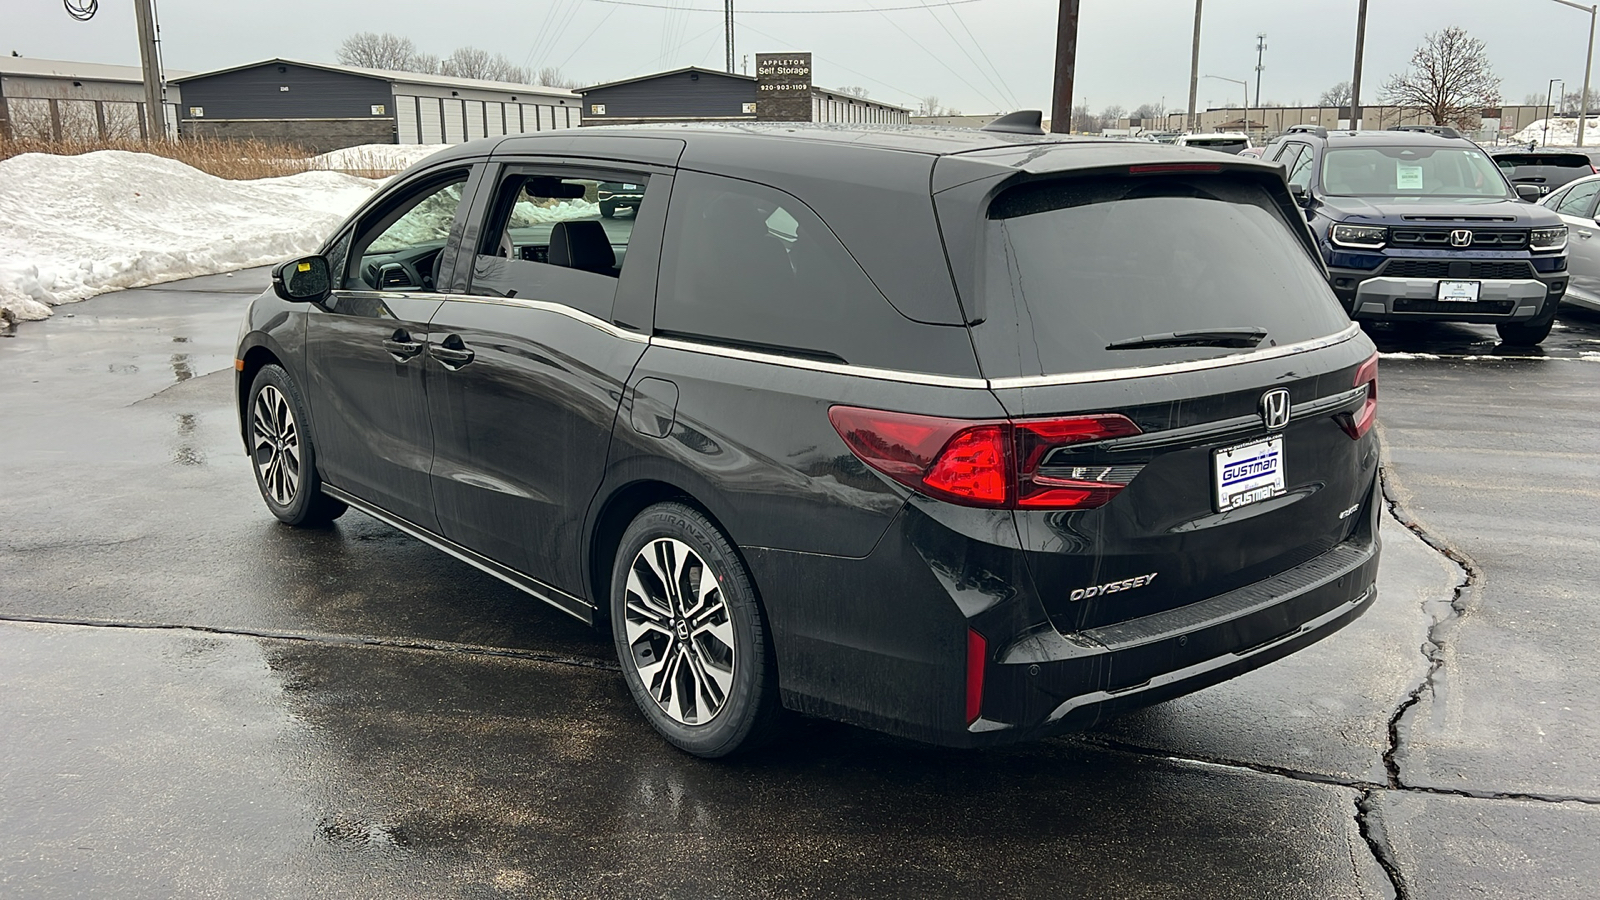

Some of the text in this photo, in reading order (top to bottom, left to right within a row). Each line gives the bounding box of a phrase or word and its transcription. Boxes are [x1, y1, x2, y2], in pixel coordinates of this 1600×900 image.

[777, 67, 809, 75] Storage
[652, 514, 713, 554] TURANZA
[1069, 572, 1158, 601] ODYSSEY
